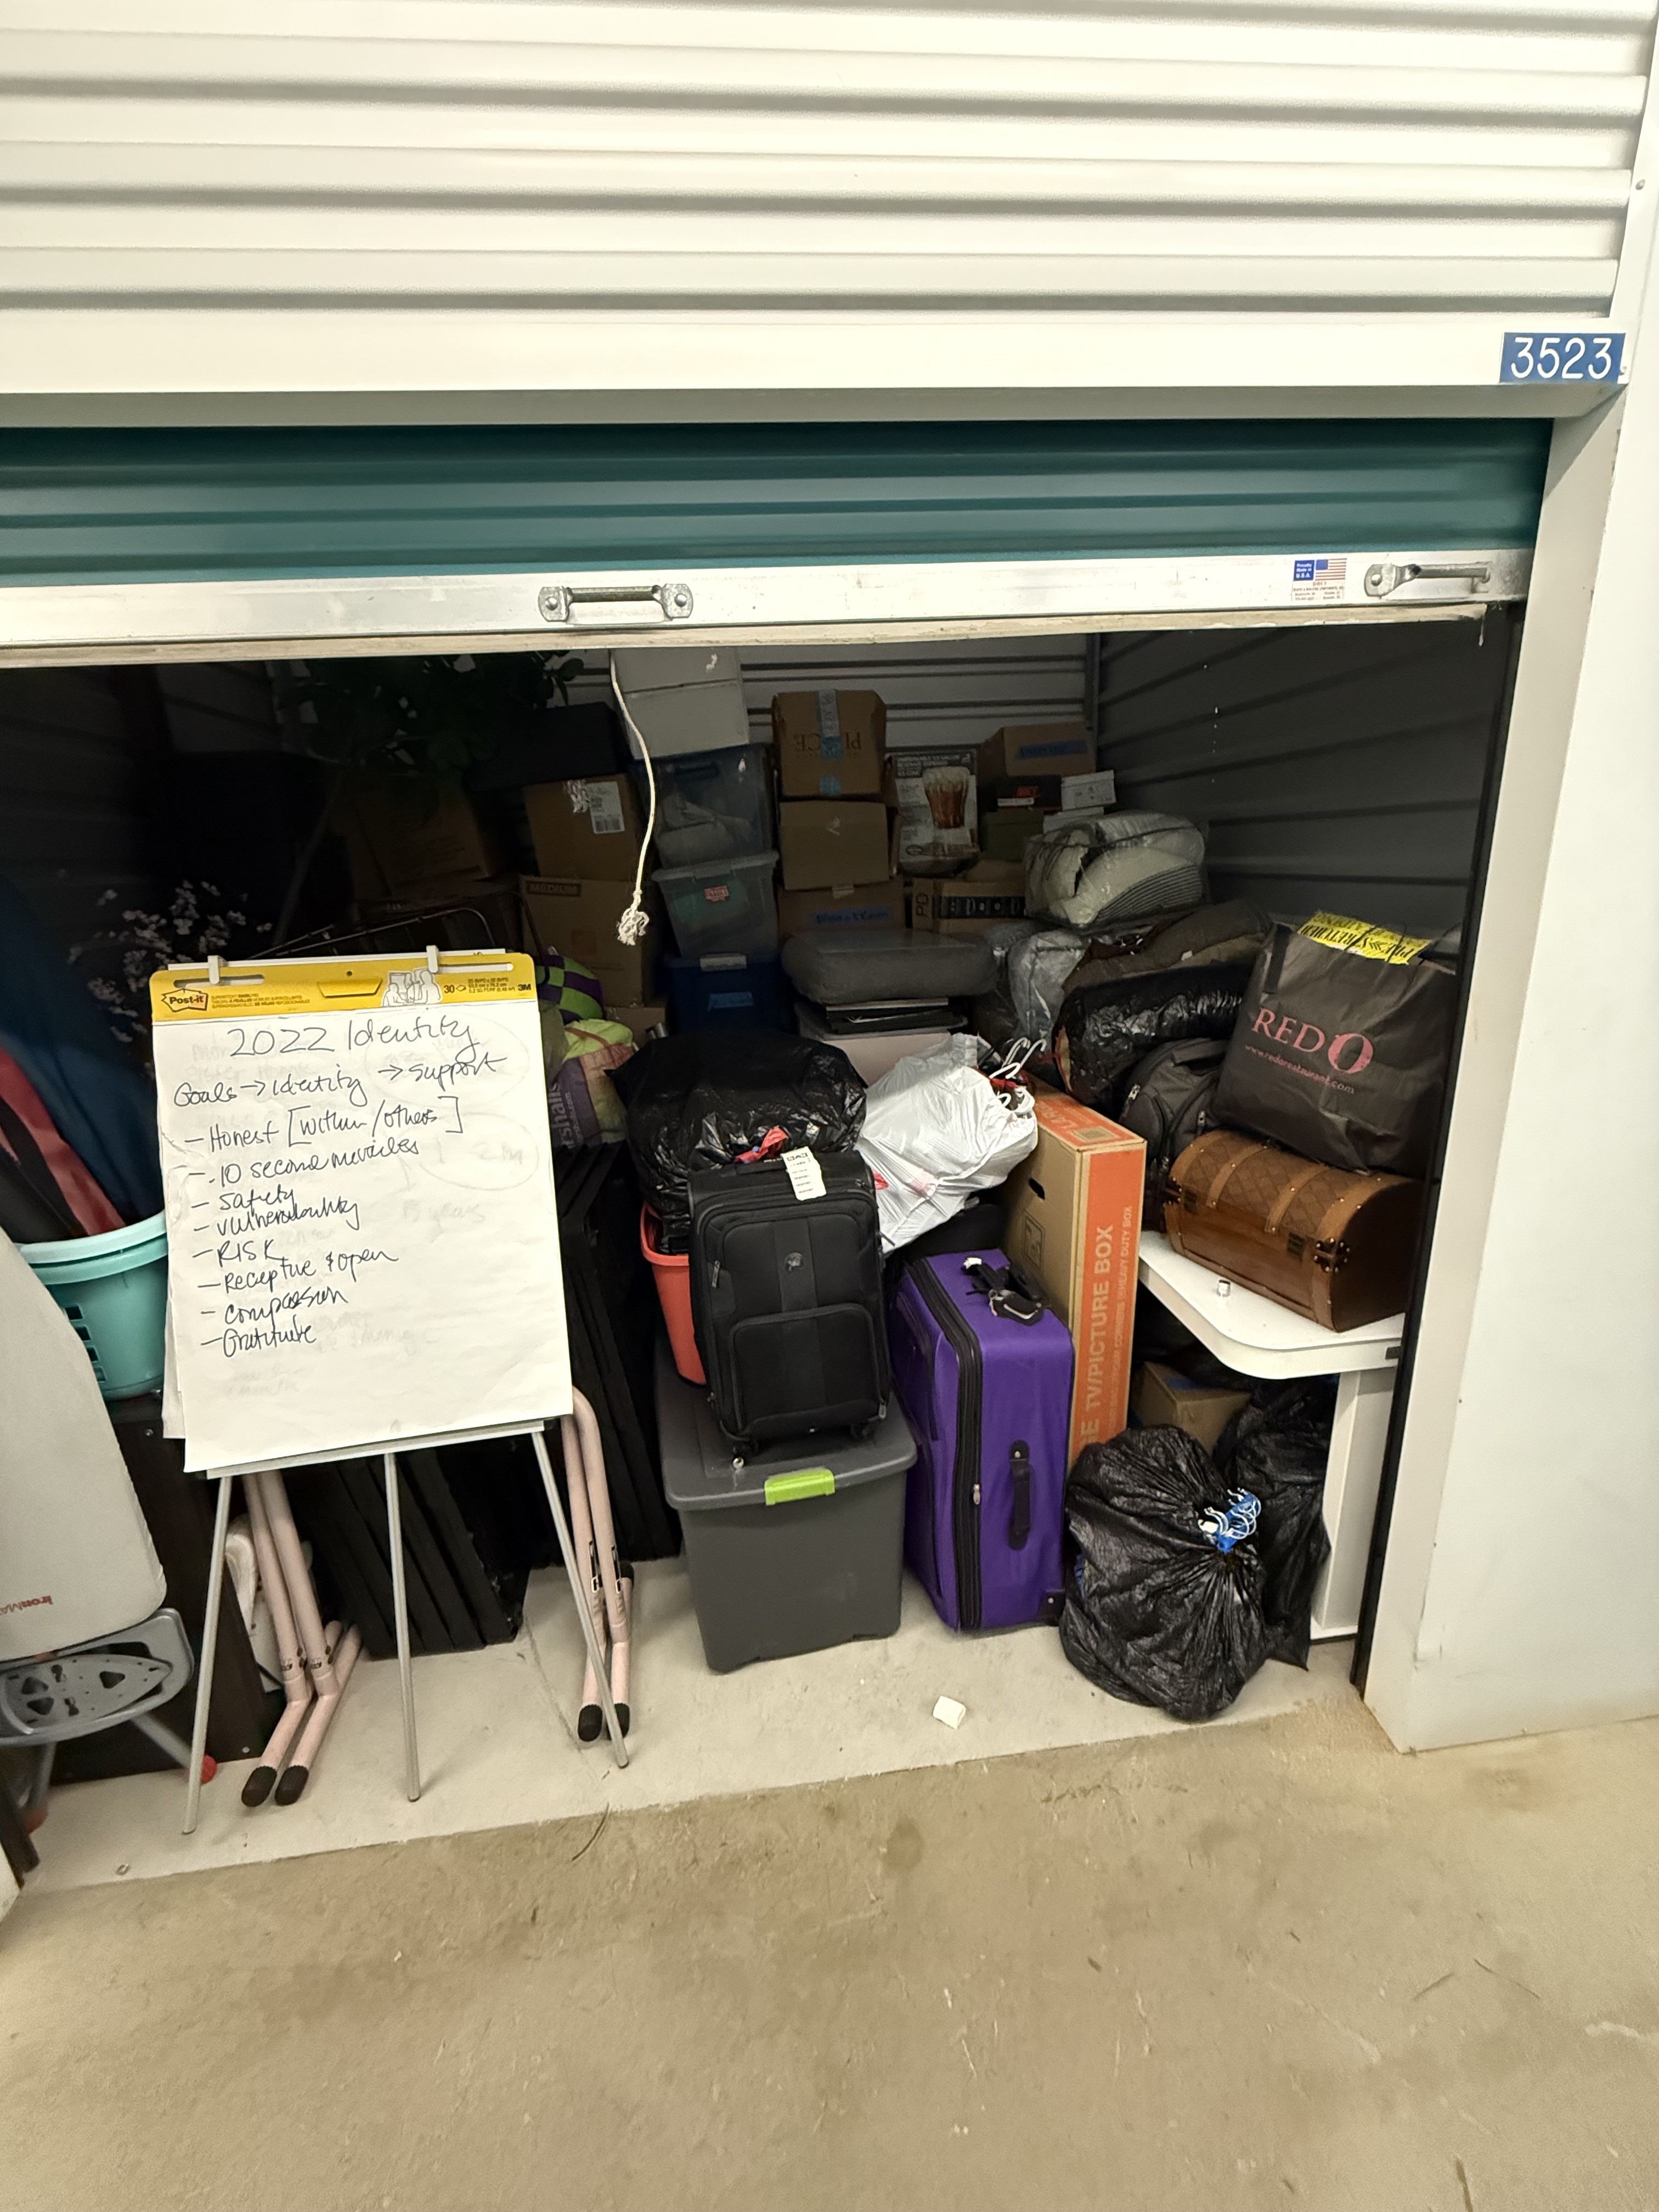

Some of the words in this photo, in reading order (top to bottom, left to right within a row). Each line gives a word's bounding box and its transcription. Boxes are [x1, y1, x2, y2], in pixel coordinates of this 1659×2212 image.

[1511, 337, 1612, 379] 3523
[530, 884, 578, 894] MEDIUM
[168, 995, 204, 1006] Post-it
[443, 984, 455, 994] 30
[228, 1028, 335, 1057] 2022
[347, 1015, 481, 1063] Identity
[1251, 1008, 1325, 1053] RED
[1328, 1032, 1373, 1074] O
[173, 1083, 238, 1107] Goals
[211, 1122, 279, 1152] Honest
[251, 1156, 328, 1179] second
[1122, 1206, 1132, 1227] BOX
[218, 1240, 287, 1267] RISK
[1094, 1225, 1114, 1274] BOX
[1120, 1230, 1130, 1257] DUTY
[1085, 1281, 1109, 1412] TV/PICTURE
